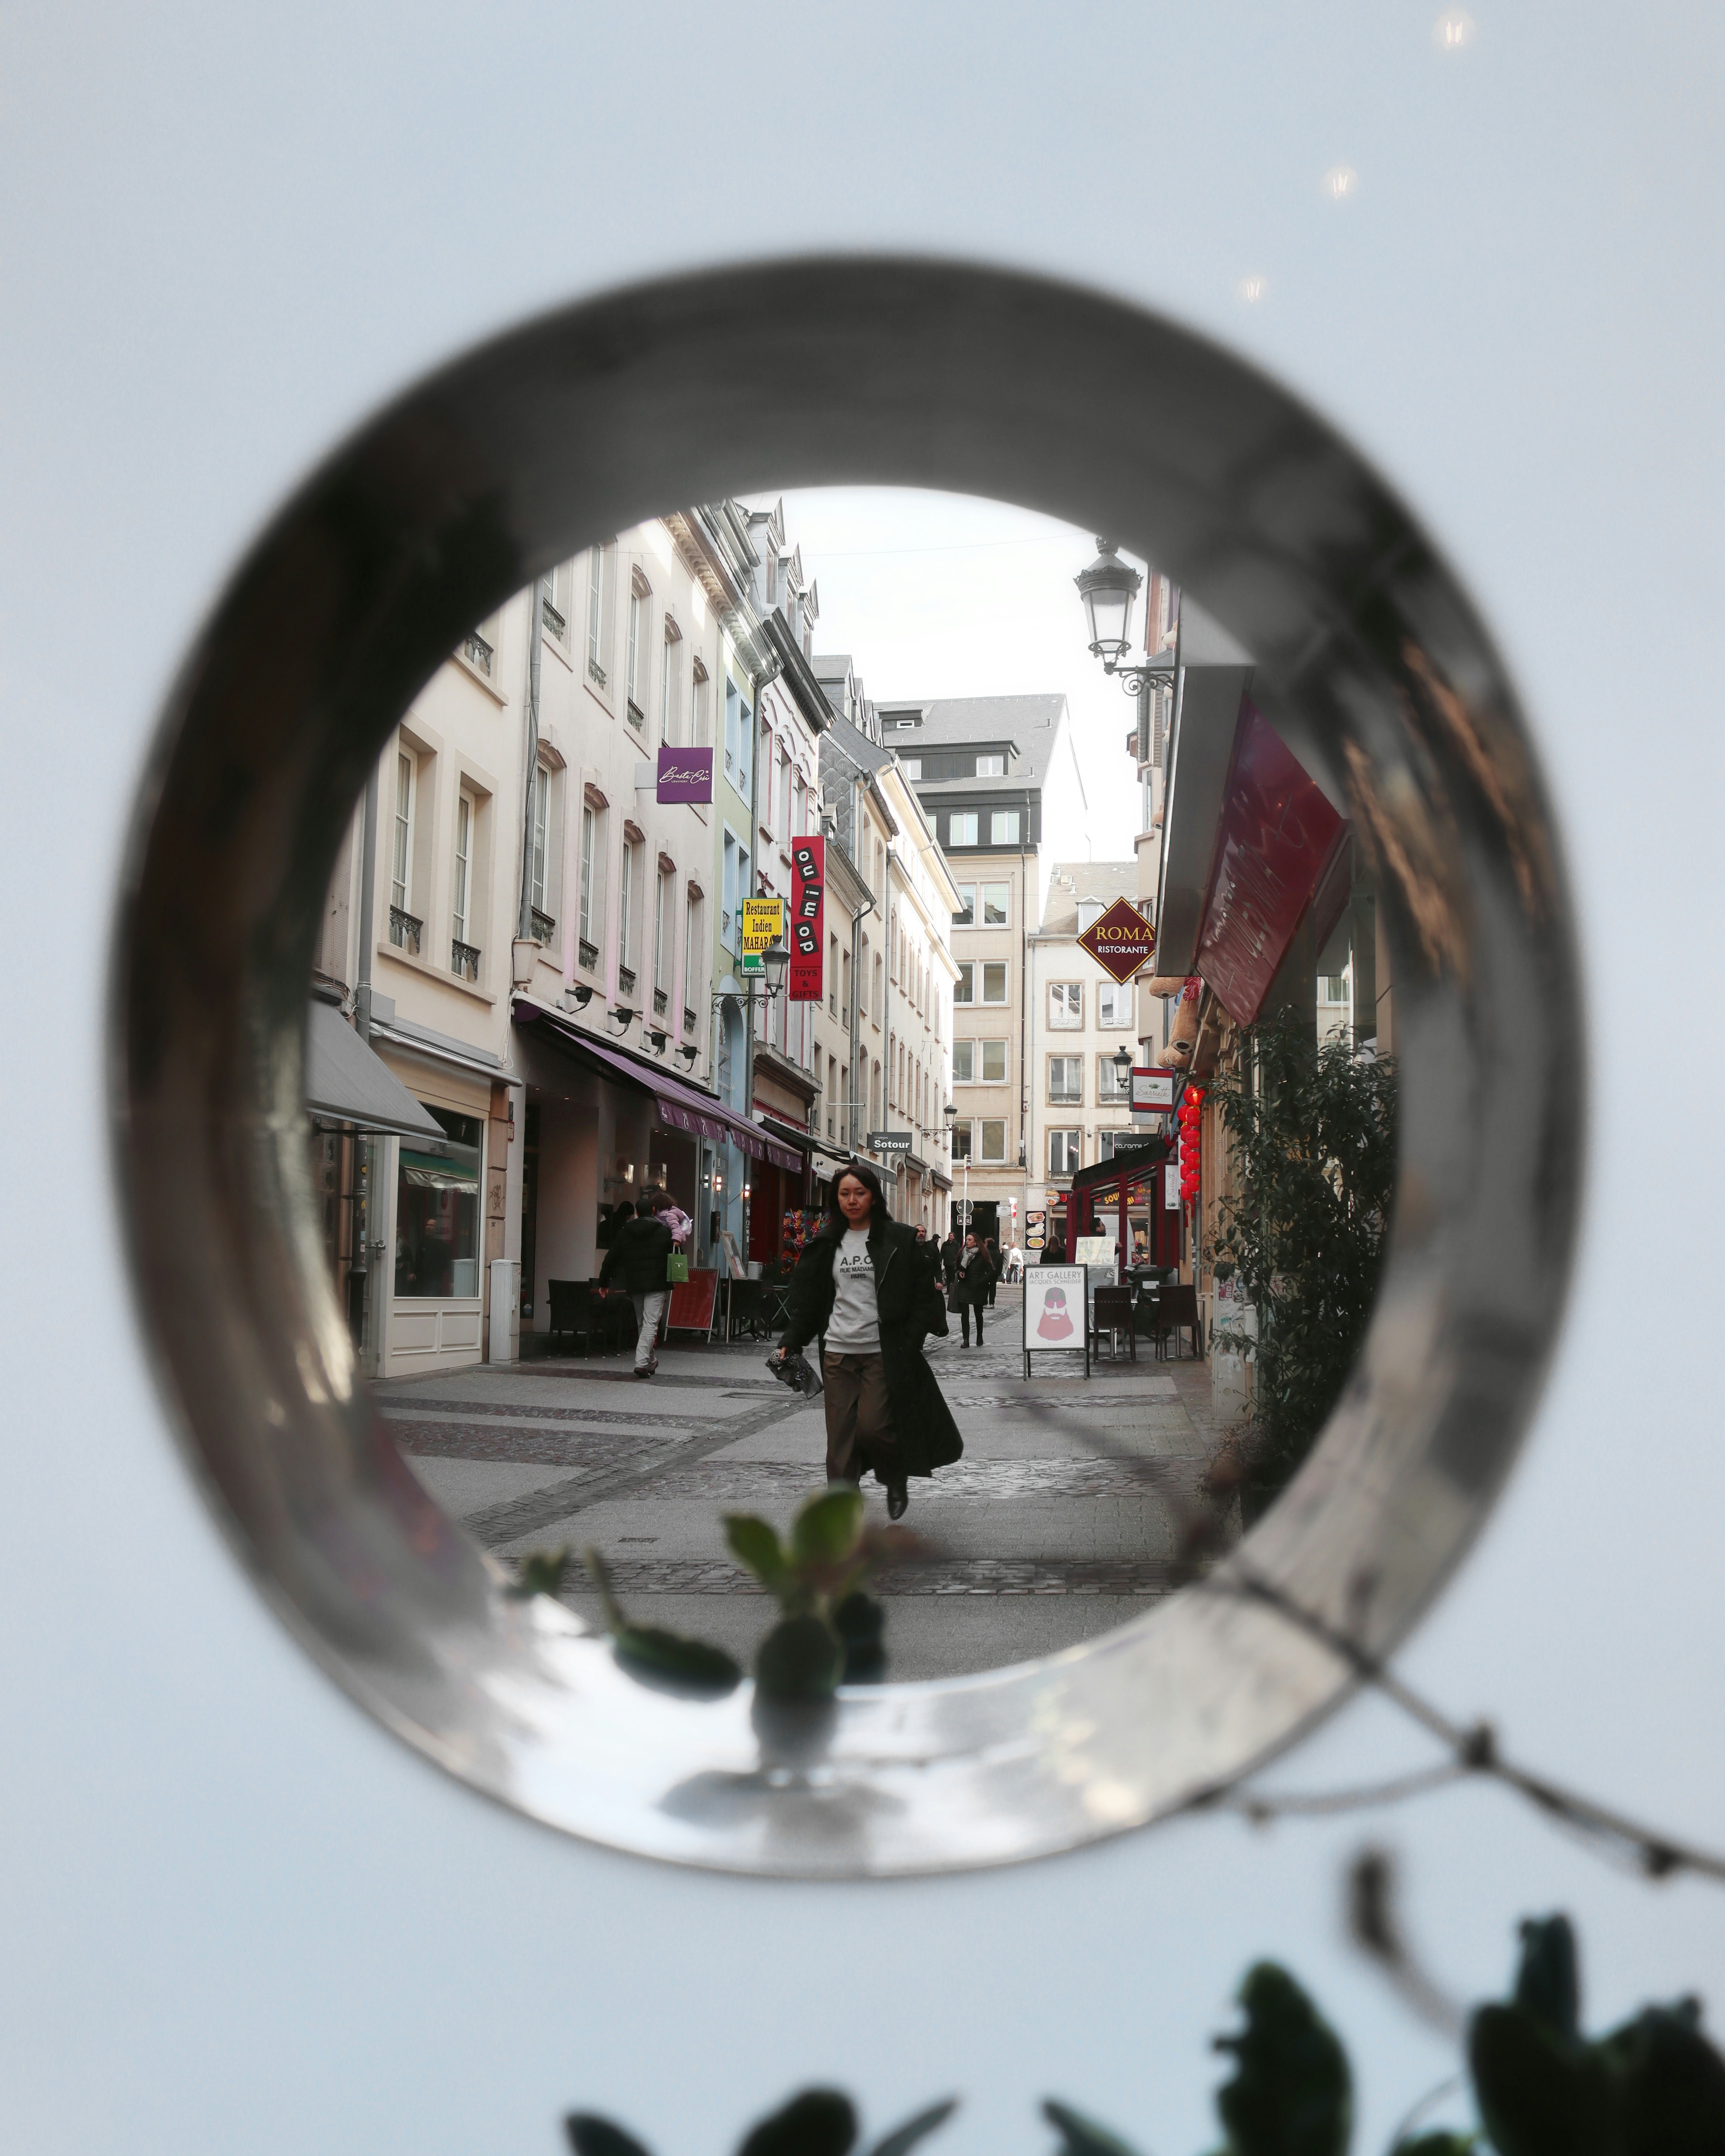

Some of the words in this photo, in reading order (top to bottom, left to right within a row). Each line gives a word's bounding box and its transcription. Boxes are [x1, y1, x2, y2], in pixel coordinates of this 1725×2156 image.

[659, 766, 694, 782] Basta
[799, 851, 819, 952] domino
[746, 902, 780, 915] Restaurant
[752, 919, 772, 932] Indien
[1095, 927, 1154, 940] ROMA
[1098, 946, 1148, 954] RISTORANTE
[874, 1140, 910, 1148] Sotour
